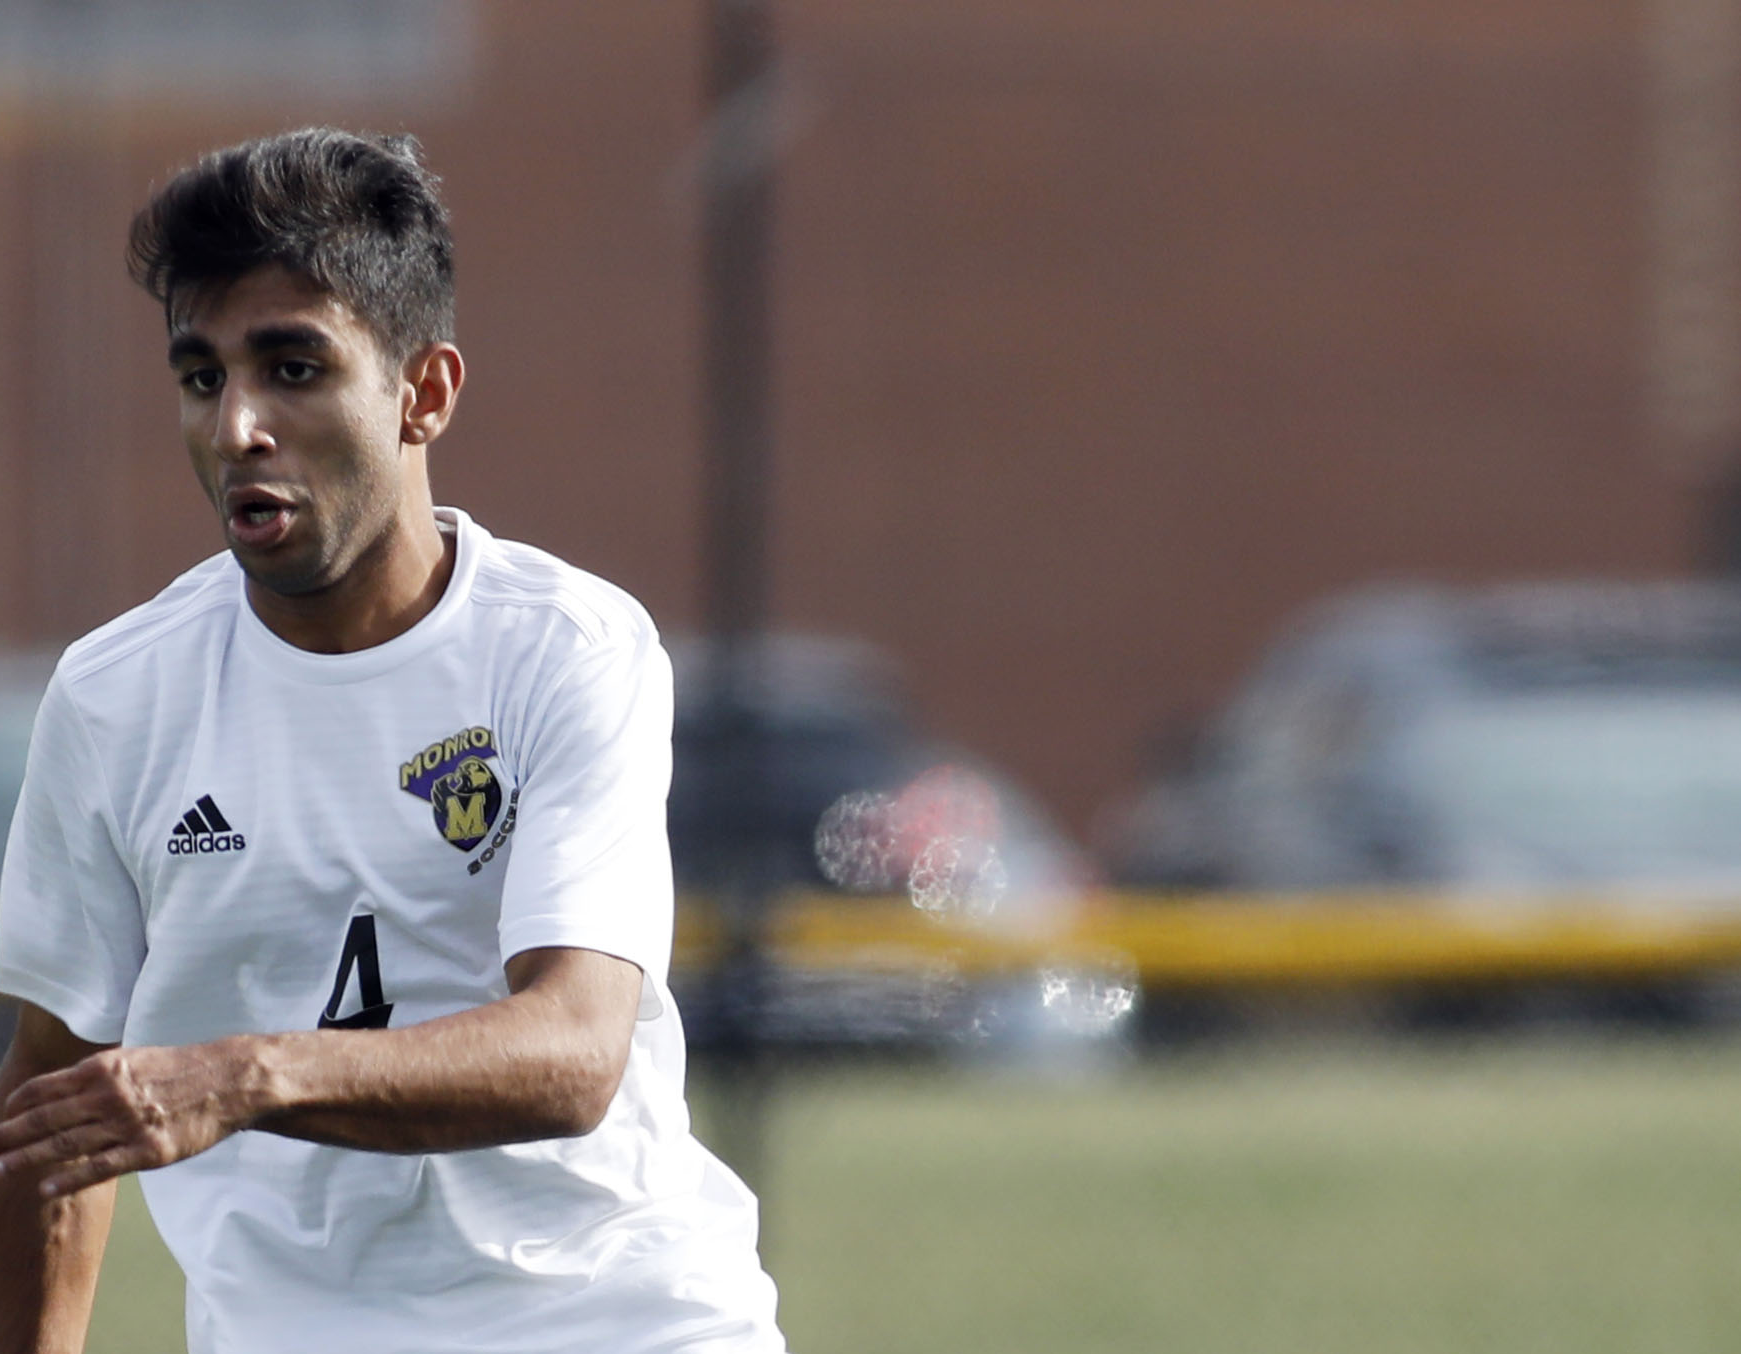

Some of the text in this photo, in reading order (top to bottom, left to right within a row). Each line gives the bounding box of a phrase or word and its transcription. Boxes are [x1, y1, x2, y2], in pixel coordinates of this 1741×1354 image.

[400, 726, 498, 790] MONRO
[167, 832, 246, 855] adidas
[446, 793, 487, 840] M
[317, 914, 394, 1031] 4
